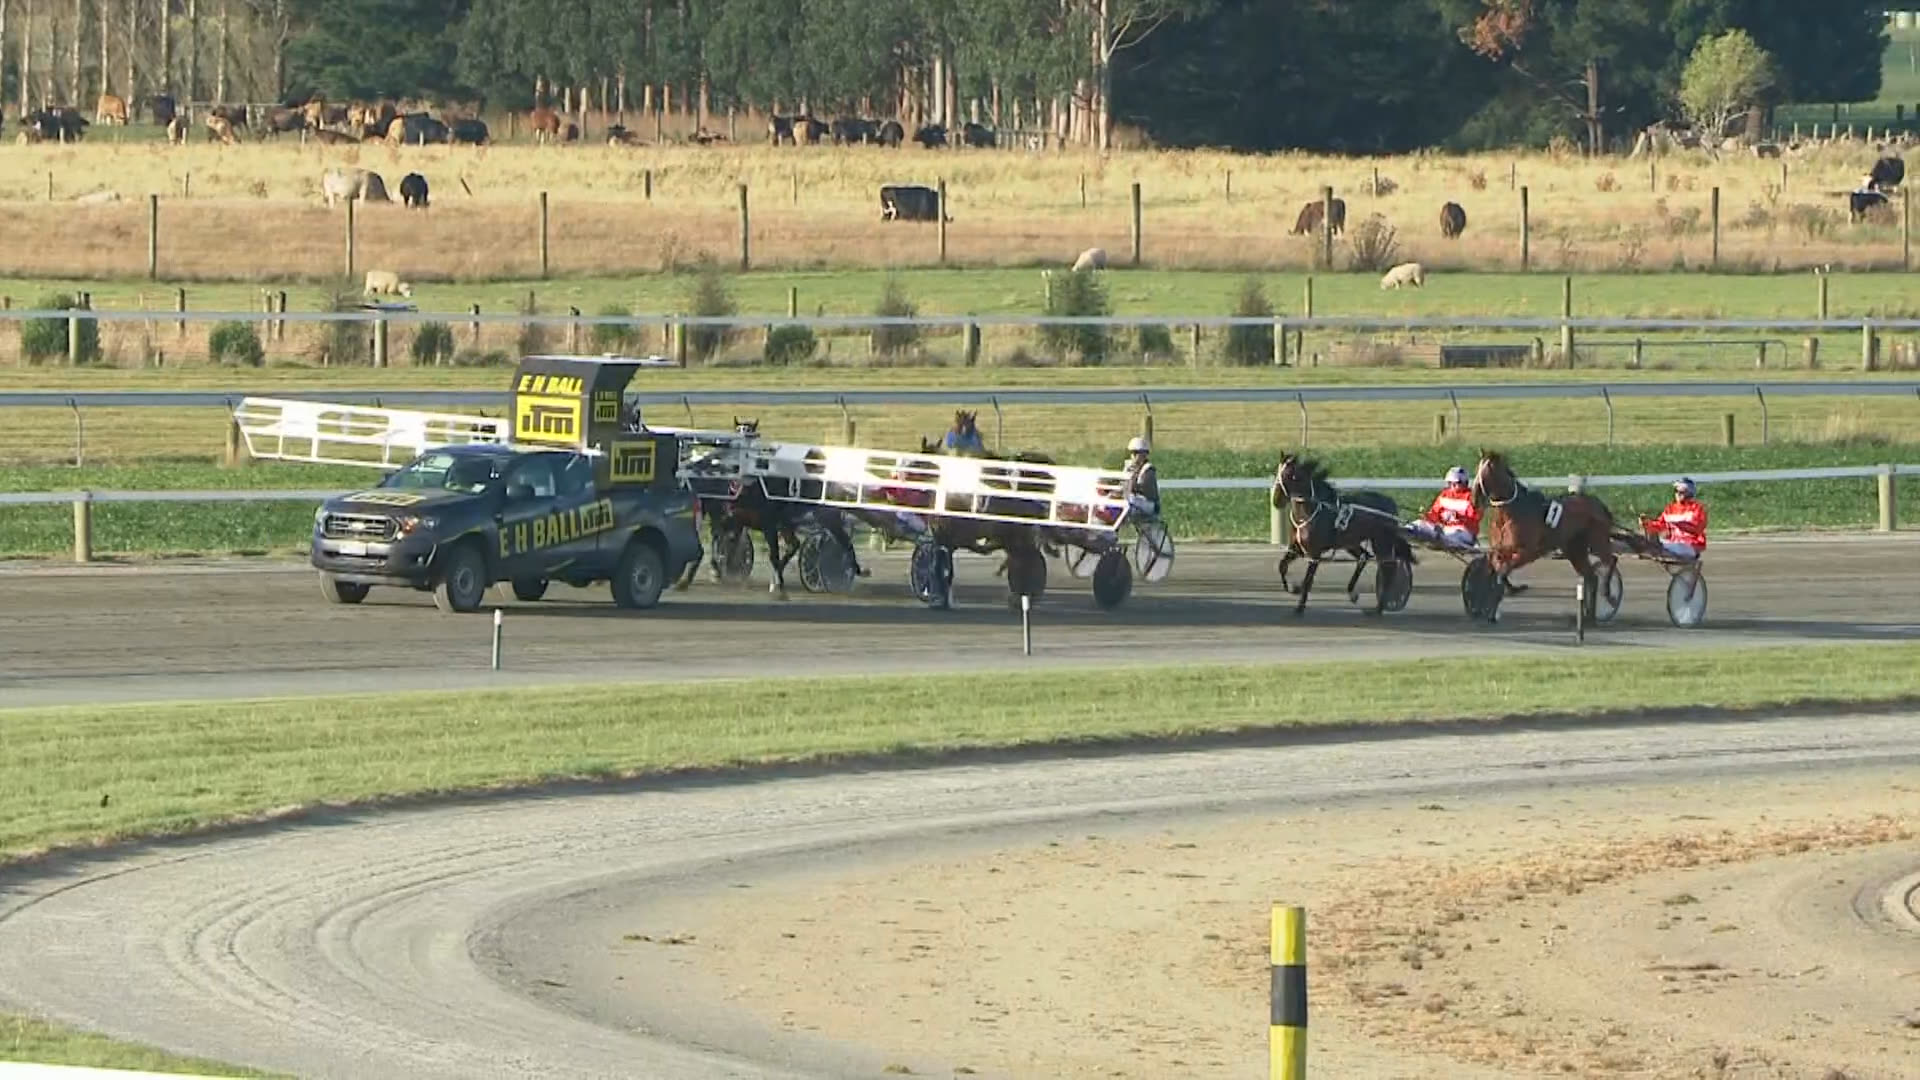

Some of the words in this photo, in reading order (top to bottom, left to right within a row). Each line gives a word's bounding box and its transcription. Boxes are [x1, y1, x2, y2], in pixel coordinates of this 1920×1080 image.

[518, 375, 532, 392] E
[531, 375, 546, 393] H
[545, 376, 583, 395] BALL
[500, 527, 510, 559] E
[515, 522, 528, 554] H
[533, 509, 580, 550] BALL
